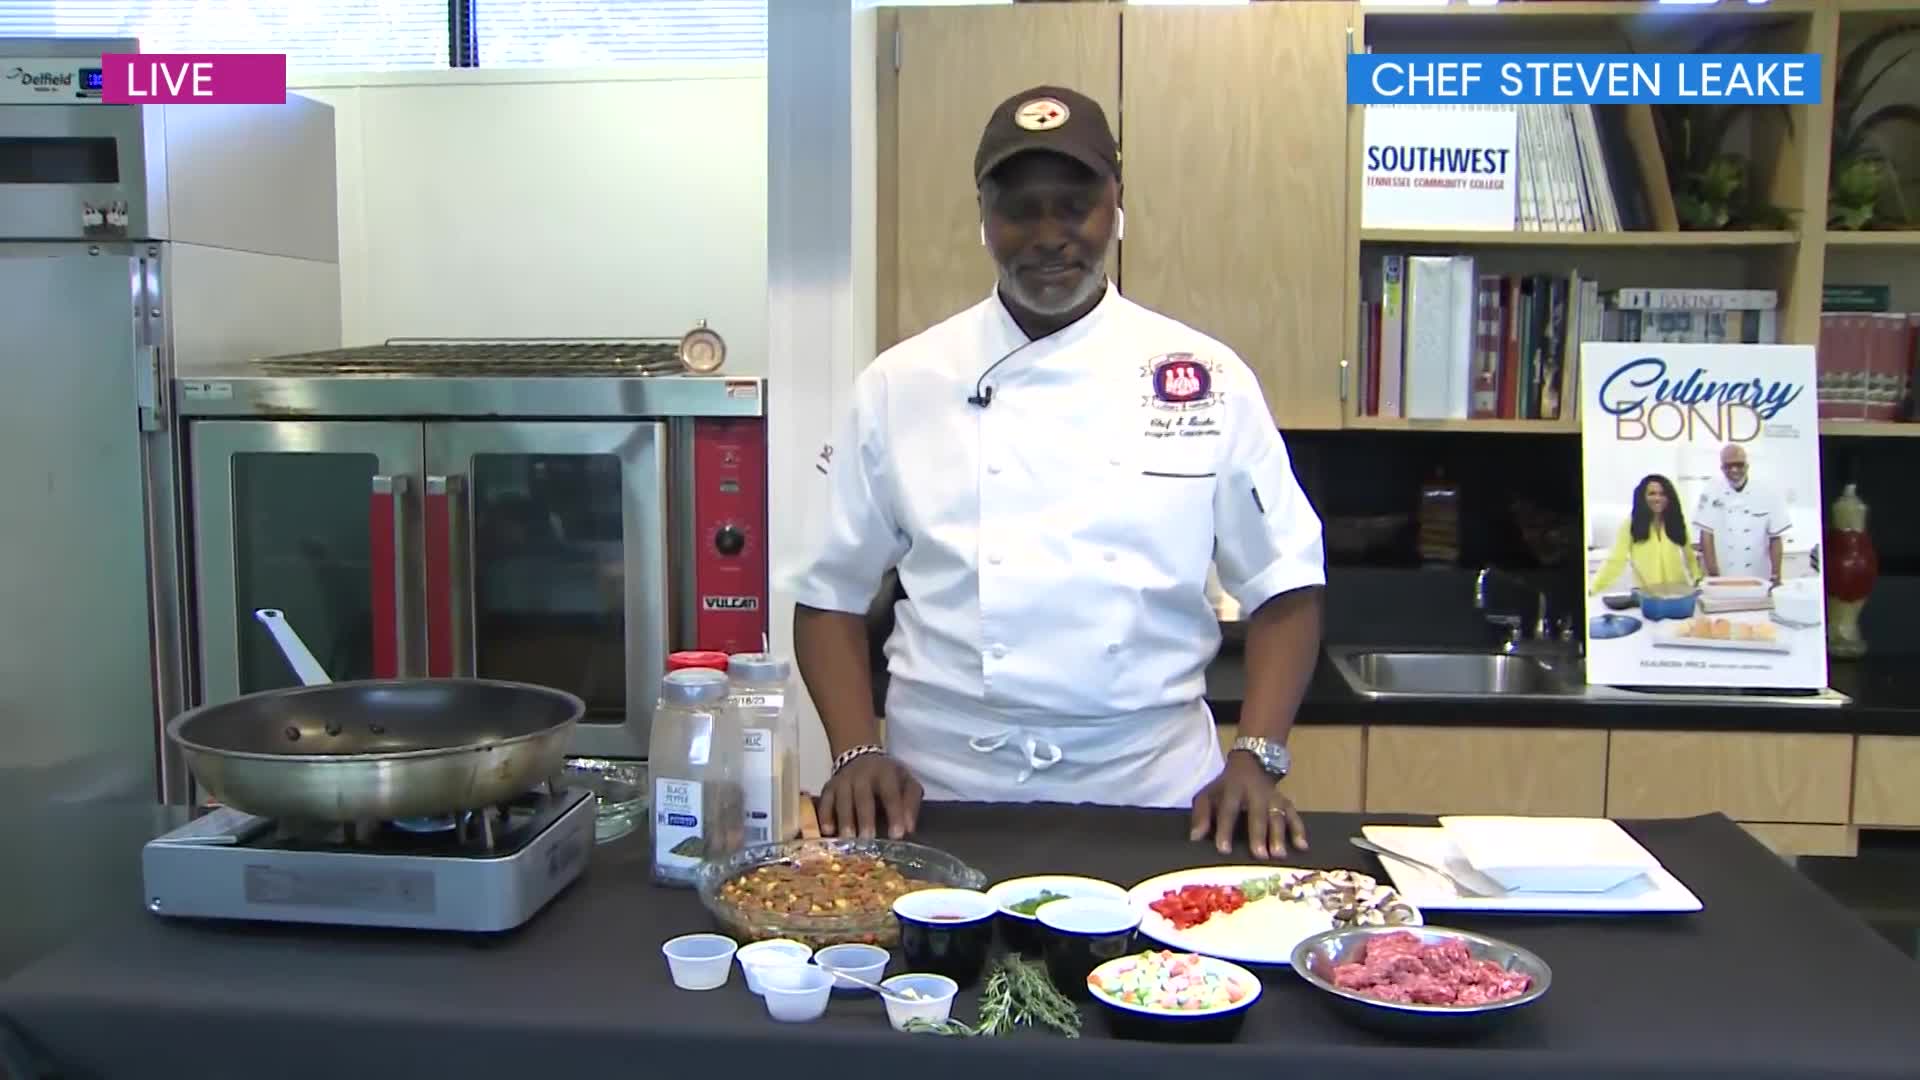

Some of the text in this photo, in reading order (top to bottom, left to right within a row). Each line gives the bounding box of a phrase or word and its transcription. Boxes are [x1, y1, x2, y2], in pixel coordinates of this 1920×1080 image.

[21, 72, 72, 86] Delfield
[1367, 145, 1510, 174] SOUTHWEST
[1366, 176, 1505, 190] TENNESSEE COMMUNITY COLLEGE
[1598, 357, 1804, 421] Culinary
[1616, 400, 1762, 442] BOND
